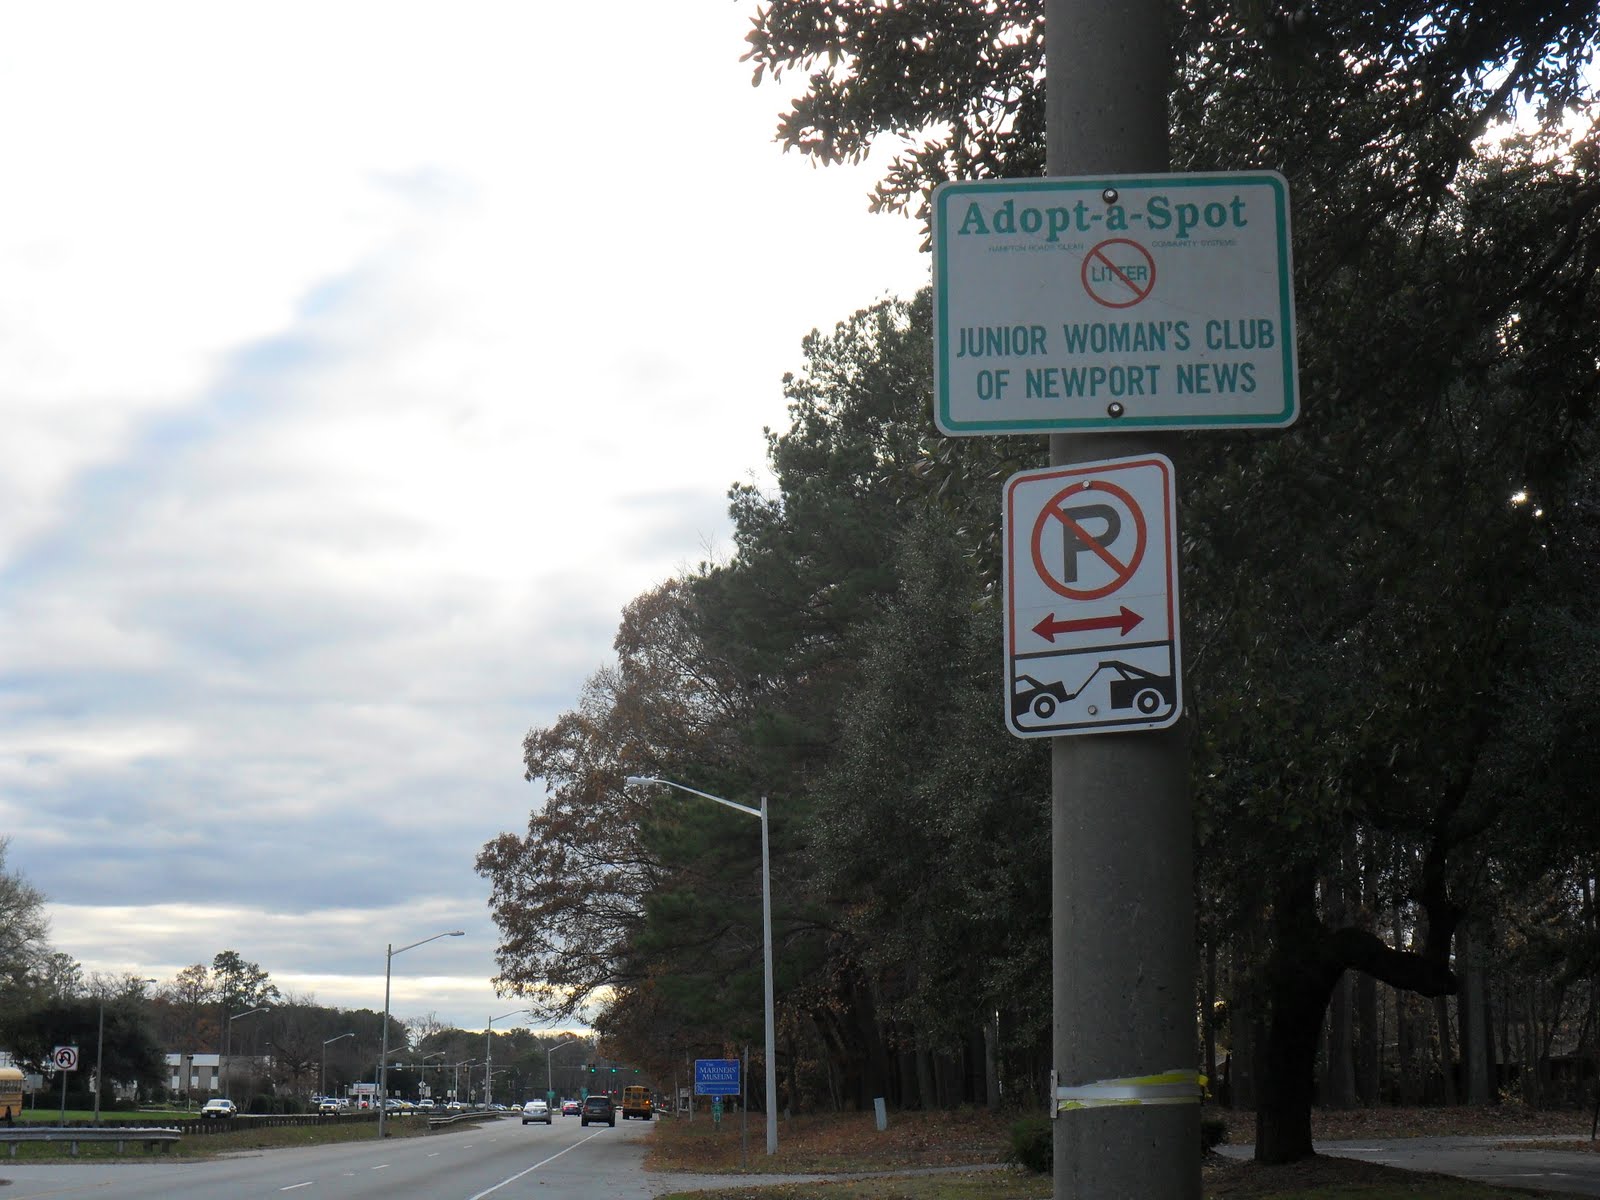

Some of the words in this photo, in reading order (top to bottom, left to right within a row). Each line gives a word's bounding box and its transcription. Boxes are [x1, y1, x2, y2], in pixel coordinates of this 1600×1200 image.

[957, 195, 1248, 242] Adopt-a-Spot
[1092, 265, 1148, 282] LITTER
[956, 325, 1048, 358] JUNIOR
[1063, 321, 1191, 354] WOMAN'S
[1205, 318, 1275, 351] CLUB
[976, 369, 1010, 401] OF
[1025, 365, 1161, 399] NEWPORT
[1176, 362, 1257, 395] NEWS
[1062, 503, 1121, 583] P
